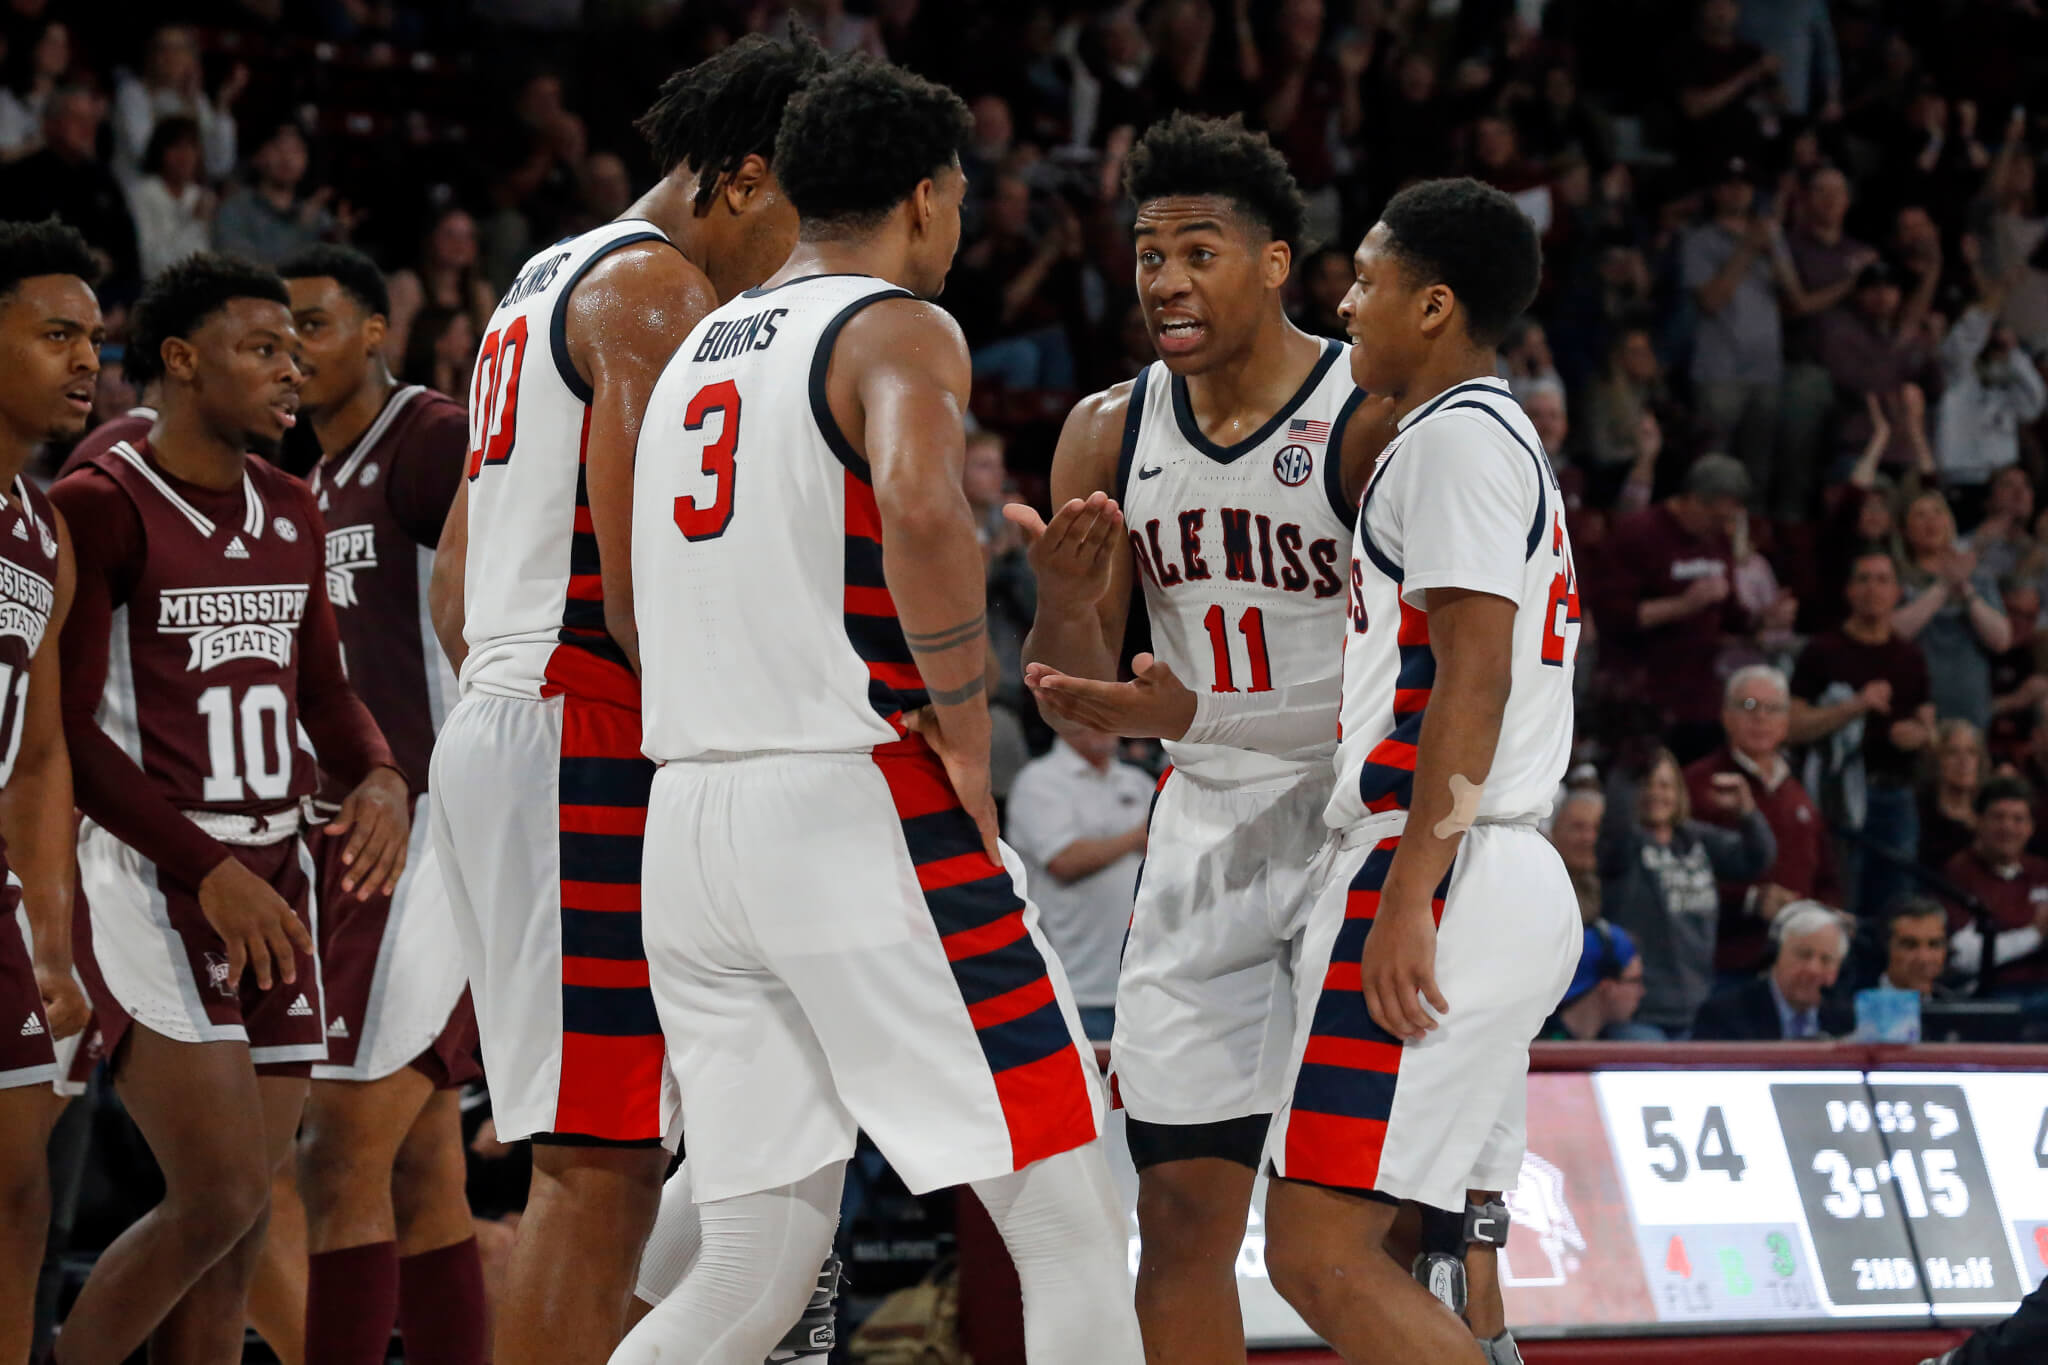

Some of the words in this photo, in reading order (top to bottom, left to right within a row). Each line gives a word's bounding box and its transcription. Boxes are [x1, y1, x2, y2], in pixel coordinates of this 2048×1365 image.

[692, 308, 789, 362] BURNS
[468, 315, 529, 482] 00
[674, 379, 742, 543] 3
[1220, 507, 1343, 599] MISS
[211, 630, 280, 659] STATE
[1203, 604, 1275, 693] 11
[197, 684, 293, 801] 10
[1641, 1105, 1748, 1182] 54
[1826, 1100, 1917, 1133] POSS
[1812, 1149, 1970, 1219] 3:15
[1852, 1258, 1917, 1290] 2ND
[1925, 1256, 1994, 1289] Half
